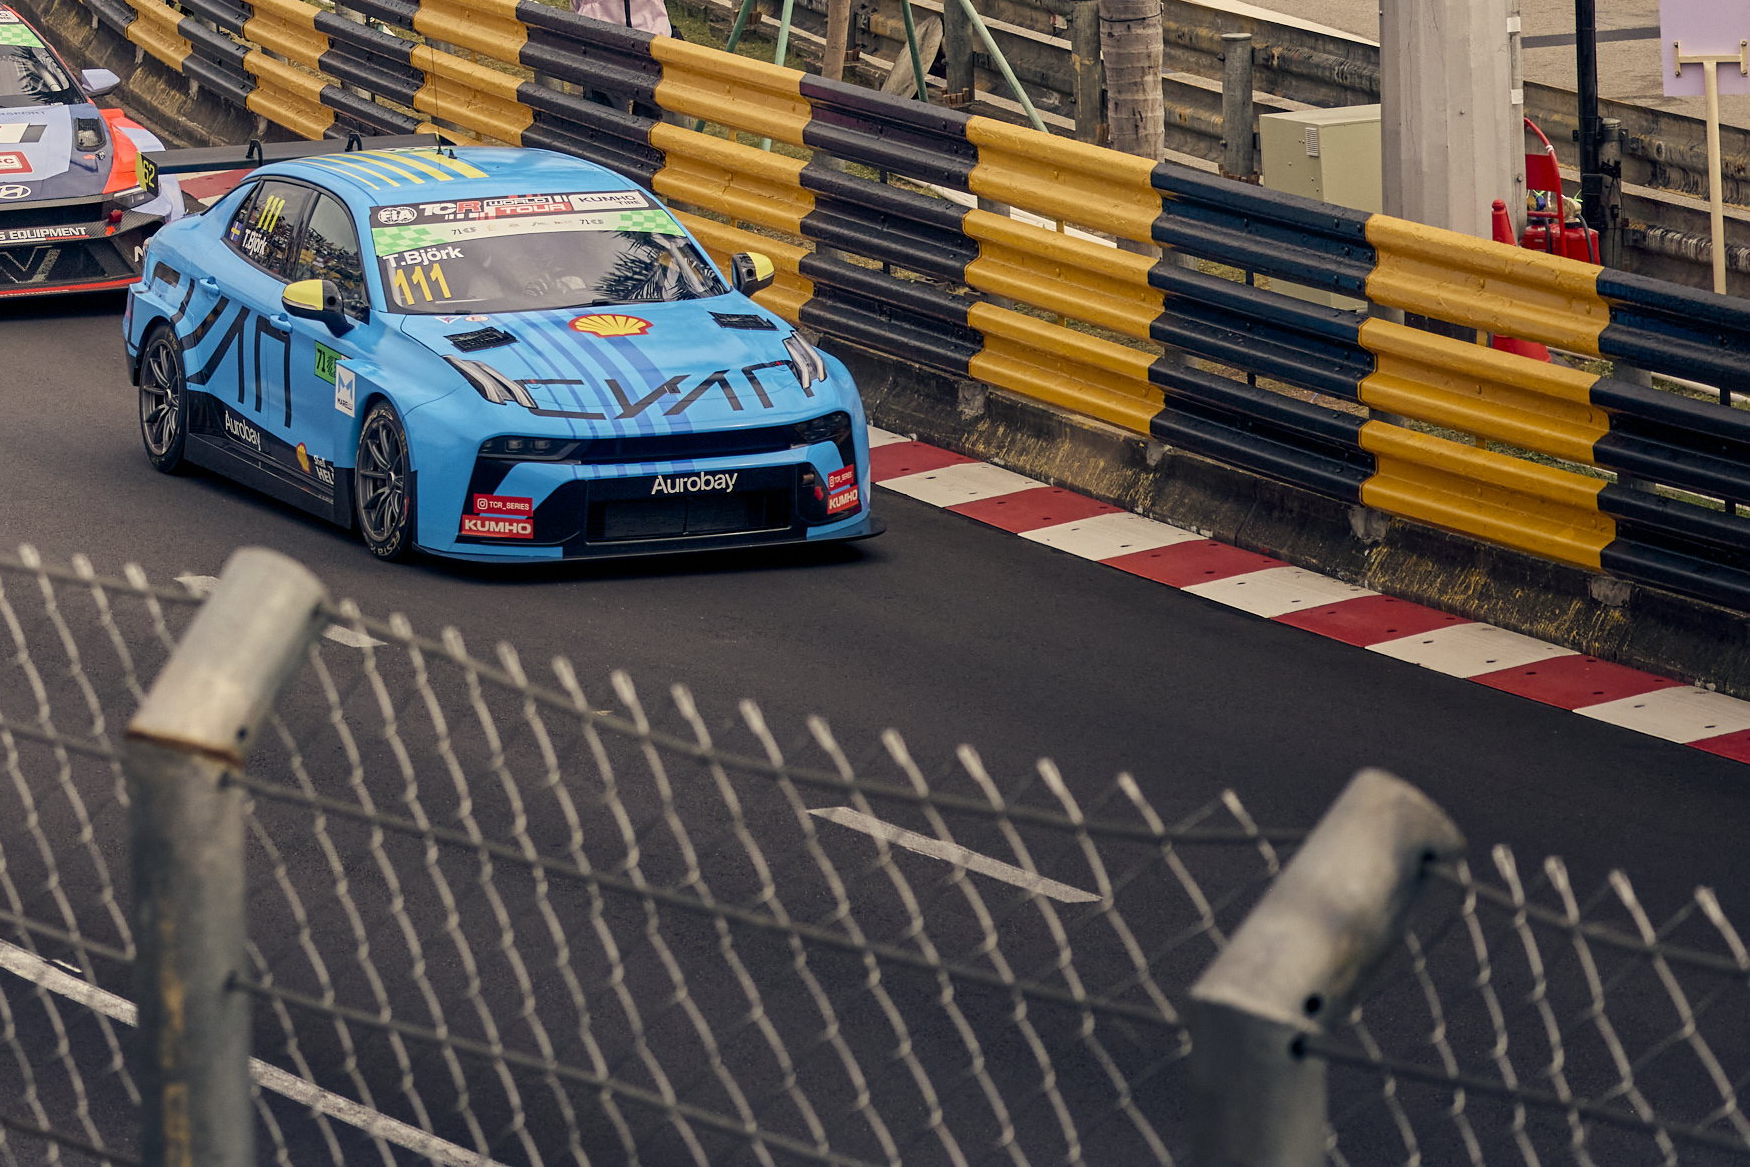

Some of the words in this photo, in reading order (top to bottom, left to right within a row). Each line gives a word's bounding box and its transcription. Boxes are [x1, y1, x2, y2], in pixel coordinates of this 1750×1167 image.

[142, 159, 155, 188] 62
[486, 196, 551, 206] WORLD
[498, 203, 566, 215] TOUR
[578, 194, 637, 204] KUMHO
[258, 195, 286, 233] 111
[380, 209, 416, 222] FIA
[419, 201, 481, 216] TCR
[8, 226, 87, 240] EQUIPMENT
[244, 228, 268, 256] T.Björk
[451, 228, 463, 236] 71
[383, 246, 464, 268] T.Björk
[393, 263, 452, 305] 111
[316, 348, 326, 373] 71
[224, 410, 262, 452] Aurobay
[651, 471, 738, 495] Aurobay
[489, 500, 530, 512] TCR_SERIES
[829, 489, 859, 510] KUMHO
[464, 519, 532, 535] KUMHO
